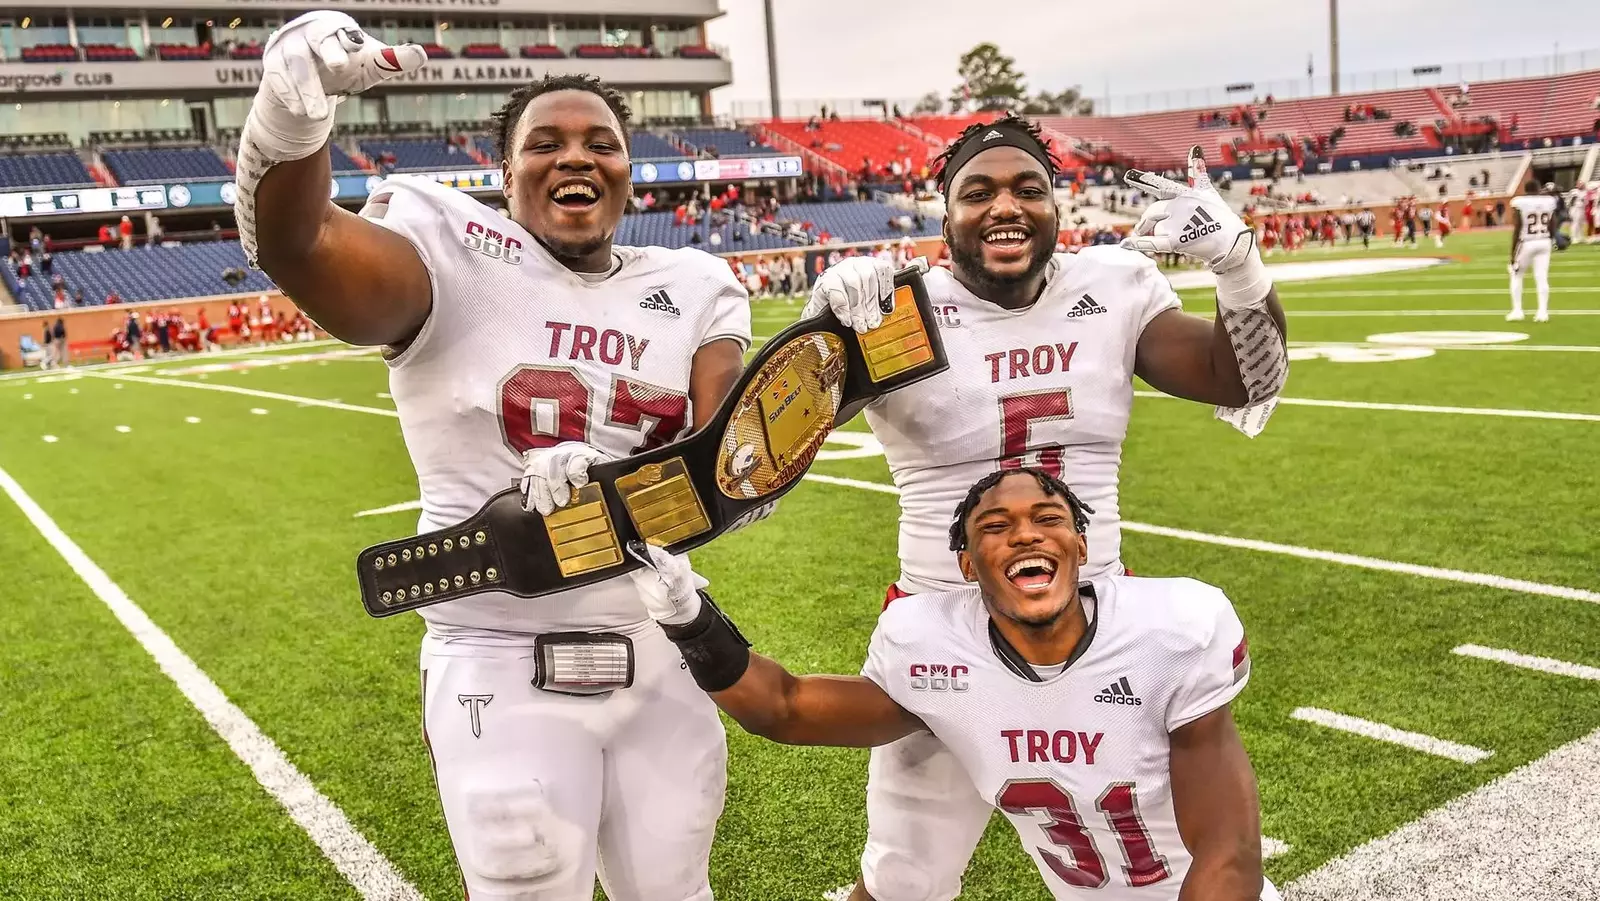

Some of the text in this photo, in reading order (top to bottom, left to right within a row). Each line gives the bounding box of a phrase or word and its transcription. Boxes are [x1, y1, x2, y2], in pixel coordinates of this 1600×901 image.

[74, 72, 113, 85] CLUB
[453, 66, 534, 80] ALABAMA
[1179, 221, 1222, 244] adidas
[1527, 212, 1549, 235] 29
[463, 220, 523, 266] SBC
[639, 300, 681, 316] adidas
[1067, 305, 1108, 319] adidas
[545, 320, 650, 372] TROY
[984, 341, 1079, 384] TROY
[769, 384, 803, 424] SUN BELT
[996, 386, 1075, 481] 5
[771, 421, 834, 489] CHAMPION
[909, 664, 970, 693] SBC
[1093, 693, 1142, 706] adidas
[1000, 729, 1105, 765] TROY
[994, 777, 1174, 889] 31
